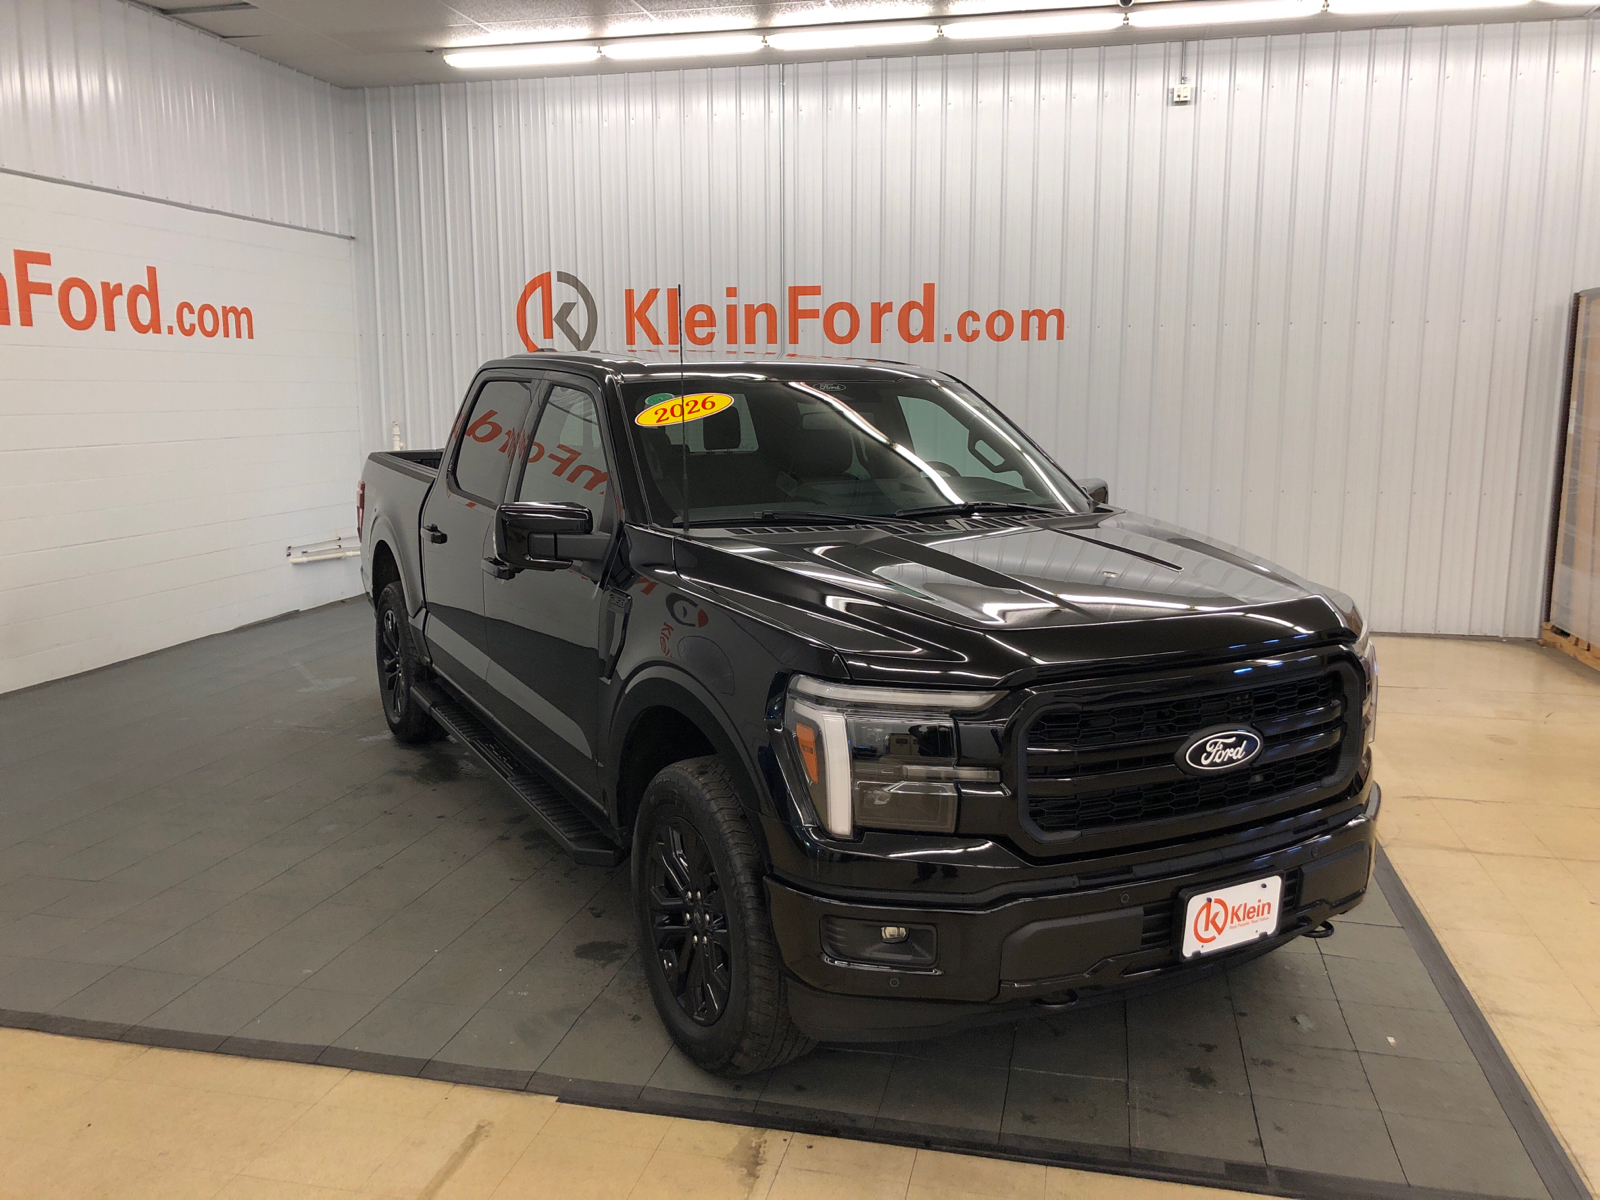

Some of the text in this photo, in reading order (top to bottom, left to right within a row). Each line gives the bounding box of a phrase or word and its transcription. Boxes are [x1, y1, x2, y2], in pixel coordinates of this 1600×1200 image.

[0, 249, 254, 339] Ford.com
[625, 283, 1065, 345] KleinFord.com
[654, 395, 716, 424] 2026
[1200, 736, 1247, 766] Ford
[1230, 898, 1271, 924] Klein
